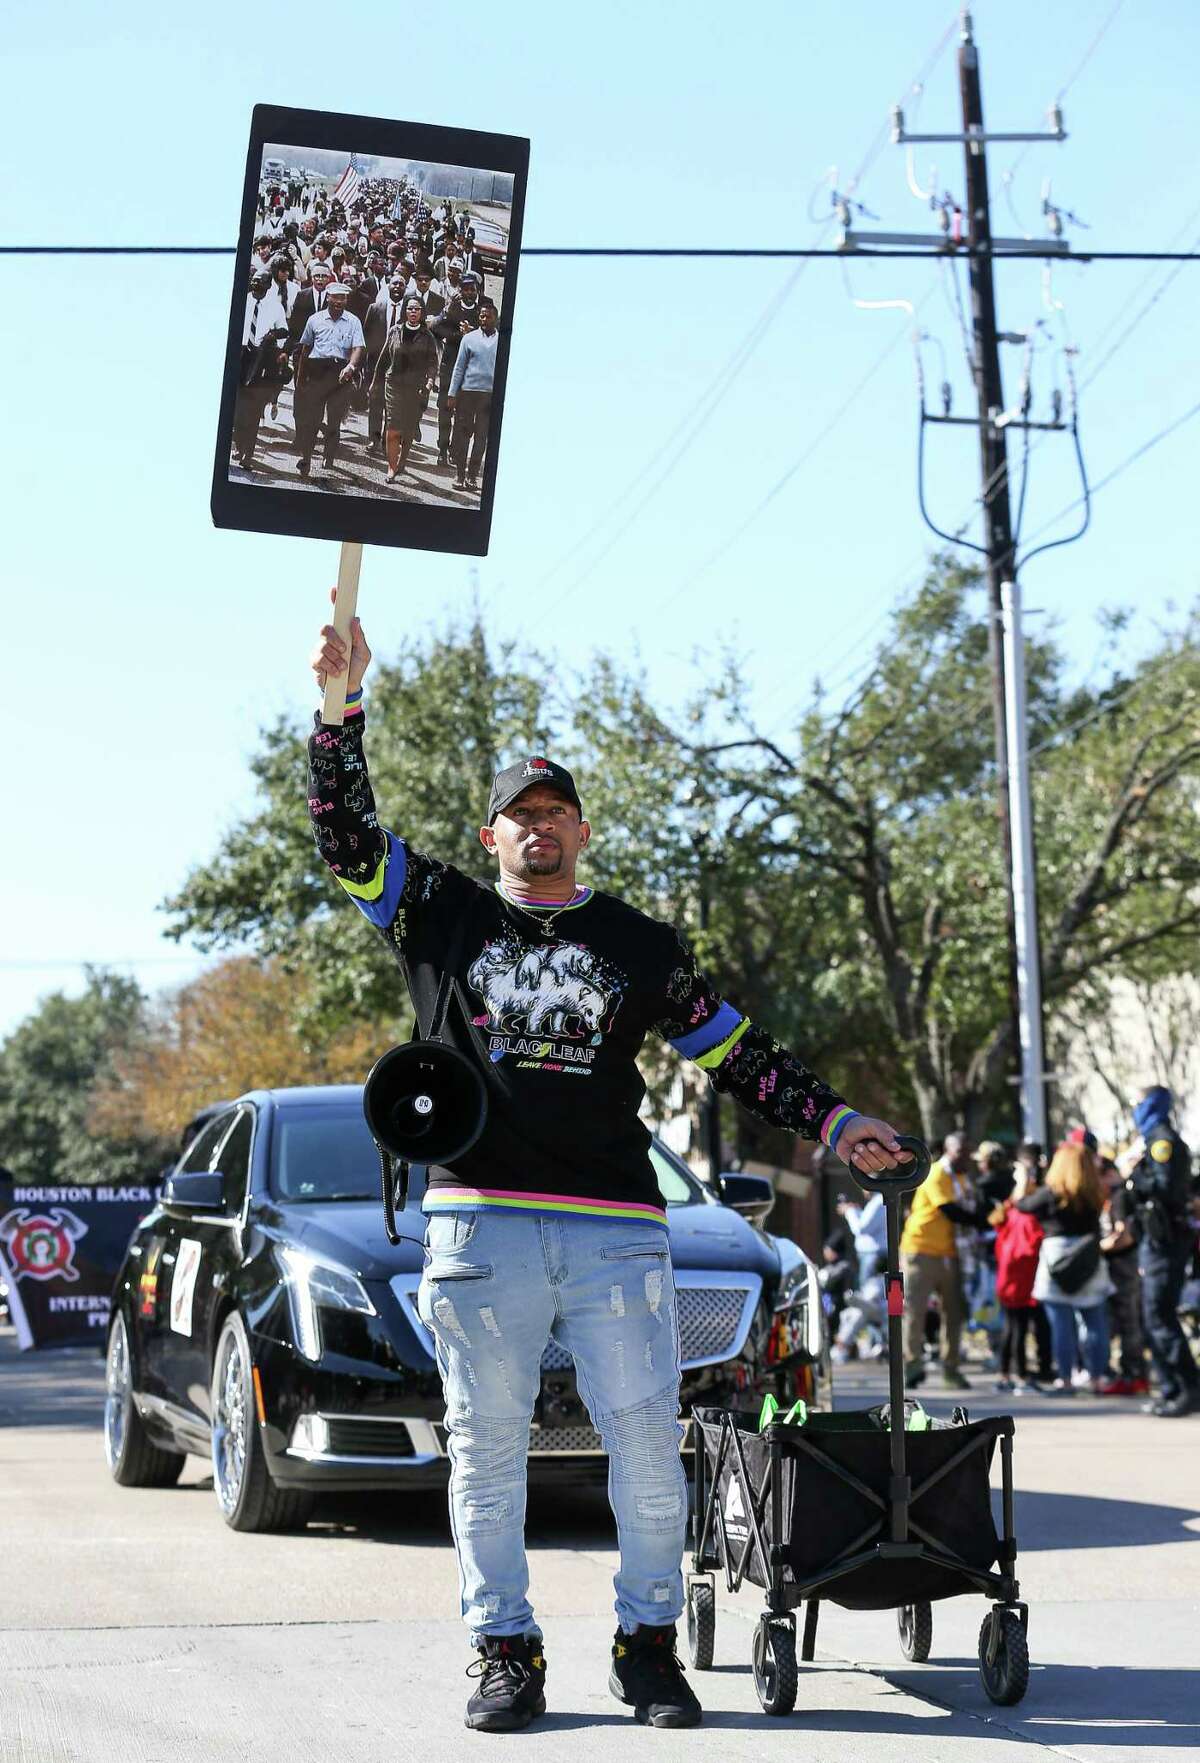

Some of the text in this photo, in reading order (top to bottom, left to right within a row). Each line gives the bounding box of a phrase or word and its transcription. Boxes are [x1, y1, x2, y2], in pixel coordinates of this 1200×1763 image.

[323, 738, 340, 750] LAC
[525, 761, 532, 770] I
[521, 768, 553, 777] JESUS
[549, 1043, 596, 1064] LEAF
[516, 1061, 542, 1069] LEAVE
[767, 1068, 778, 1093] LEAF
[758, 1076, 768, 1101] BLAC
[13, 1187, 92, 1202] HOUSTON
[96, 1187, 150, 1202] BLACK
